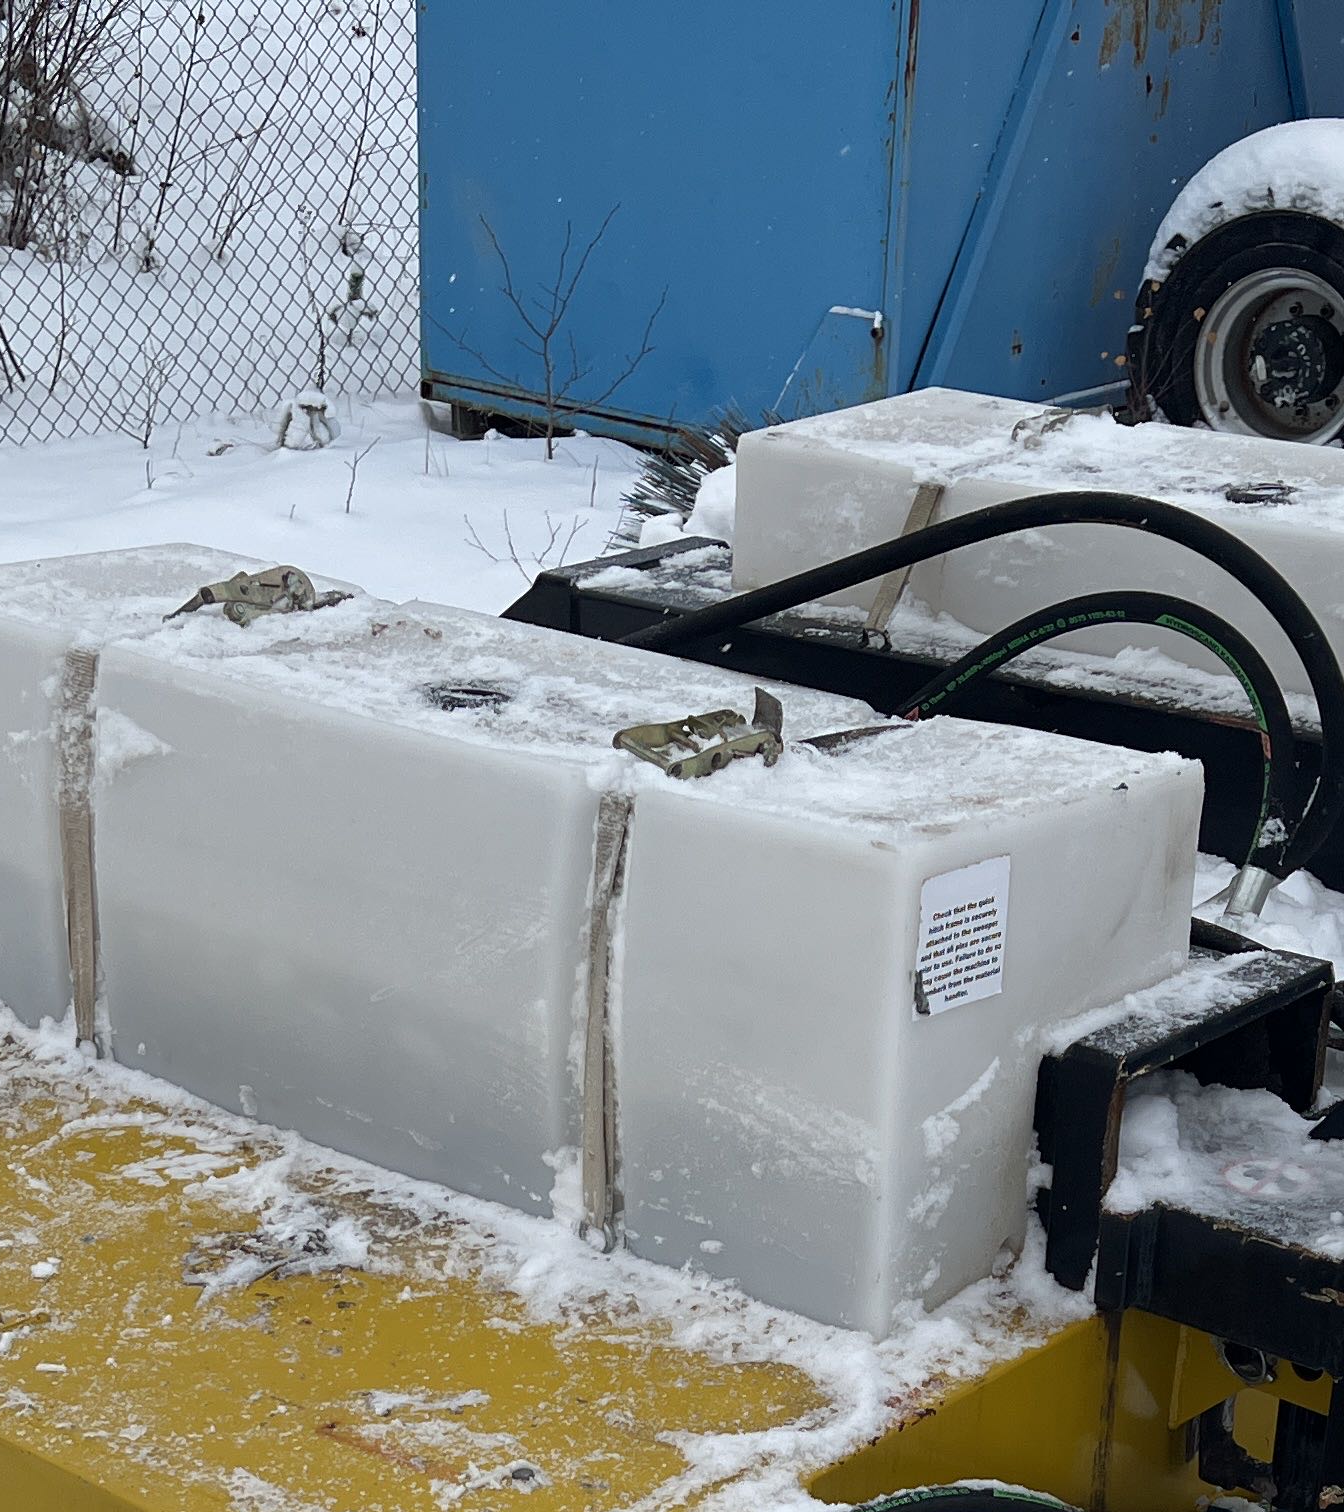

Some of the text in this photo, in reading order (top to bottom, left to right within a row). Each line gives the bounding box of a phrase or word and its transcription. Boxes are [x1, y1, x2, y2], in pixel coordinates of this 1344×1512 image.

[932, 909, 952, 921] Check
[953, 904, 966, 915] that
[967, 902, 977, 910] the
[945, 918, 963, 930] frame
[964, 916, 970, 924] is
[971, 908, 997, 921] securely
[921, 953, 932, 962] and
[933, 949, 945, 959] that
[955, 941, 968, 952] pins
[969, 938, 979, 946] are
[981, 931, 1001, 943] secure
[926, 921, 998, 948] attached to the sweeper
[955, 951, 976, 963] Failure
[977, 948, 984, 957] to
[985, 946, 993, 954] do
[934, 972, 952, 982] cause
[953, 967, 963, 976] the
[964, 959, 990, 972] machine
[991, 955, 998, 963] to
[948, 980, 962, 990] from
[963, 975, 974, 984] the
[975, 966, 1001, 981] material
